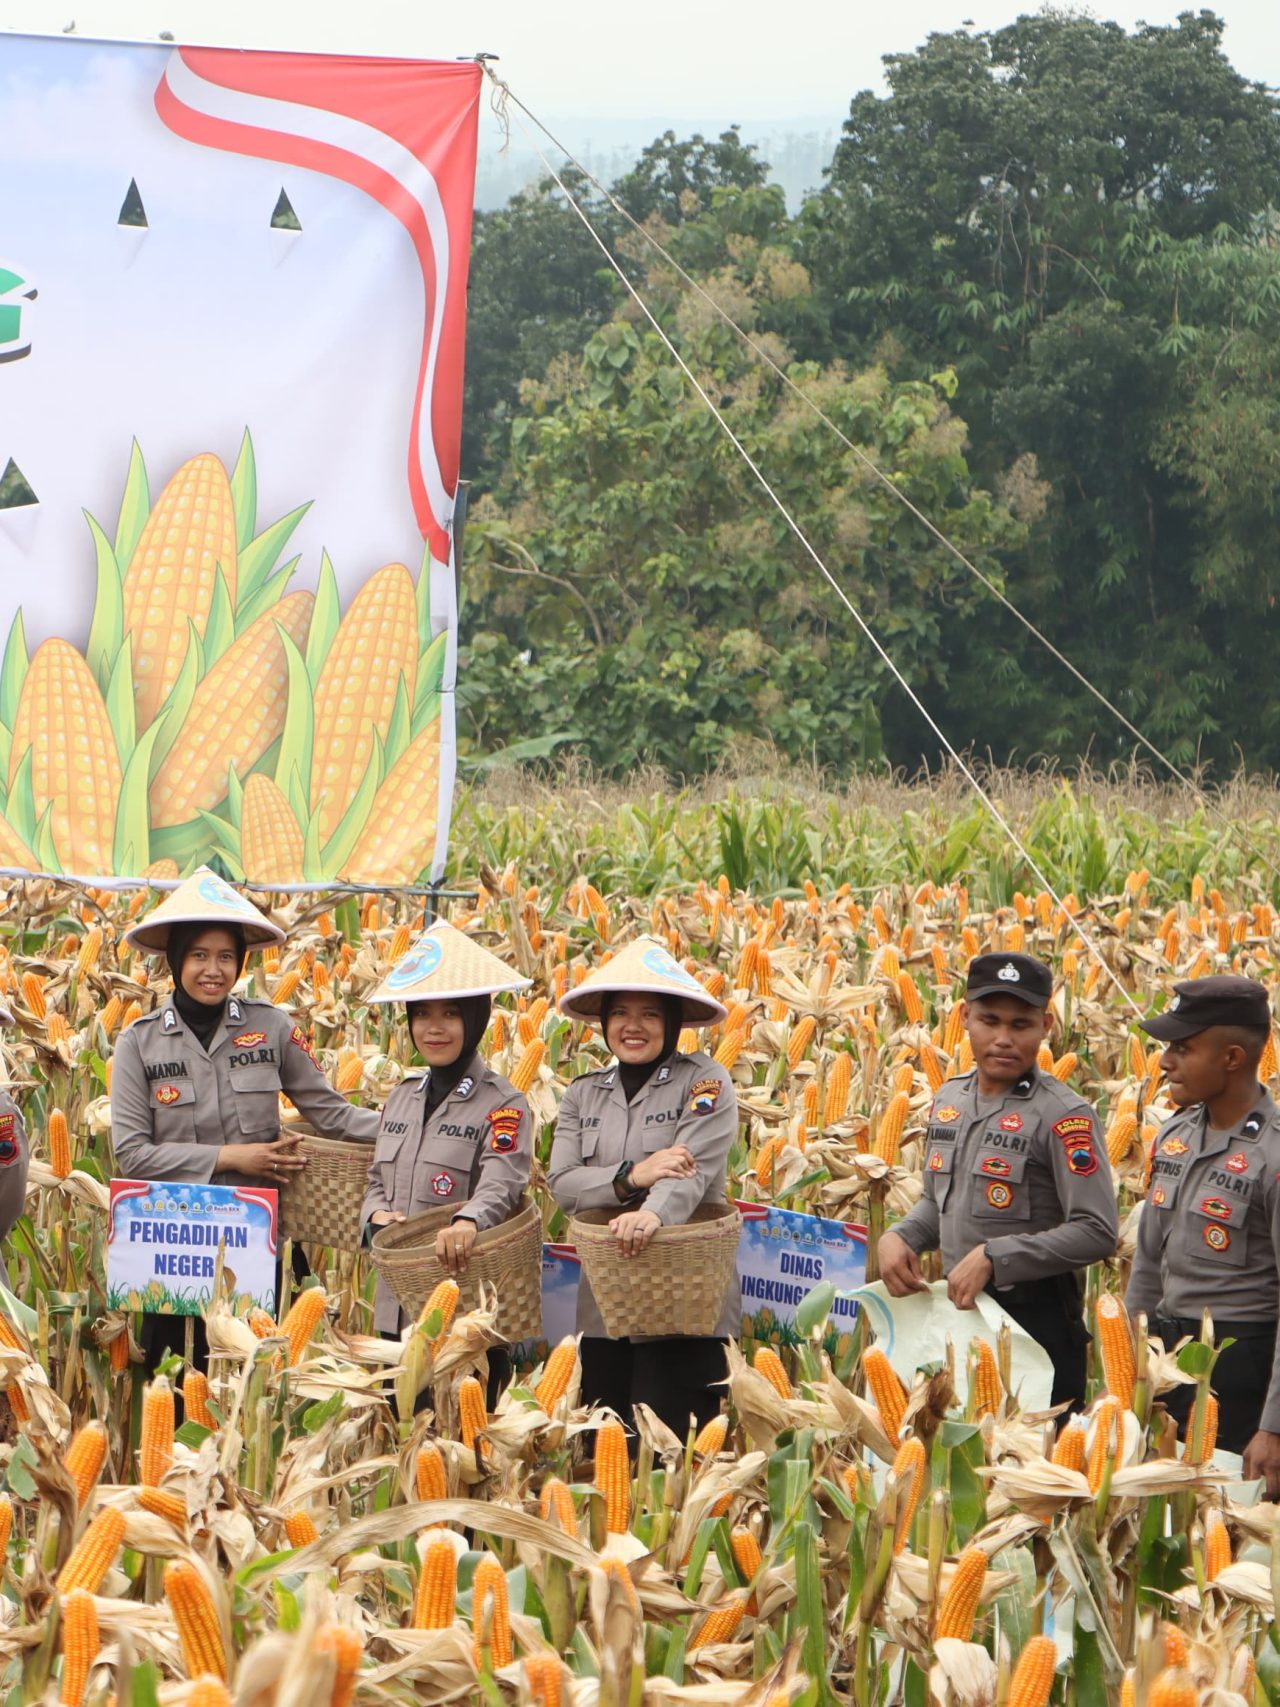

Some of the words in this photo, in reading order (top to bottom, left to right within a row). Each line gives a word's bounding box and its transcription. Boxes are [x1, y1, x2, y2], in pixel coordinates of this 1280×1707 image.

[229, 1049, 275, 1068] POLRI
[438, 1124, 480, 1141] POLRI
[985, 1132, 1027, 1152] POLRI
[1208, 1171, 1250, 1195] POLRI
[154, 1253, 214, 1277] NEGER
[780, 1252, 823, 1280] DINAS
